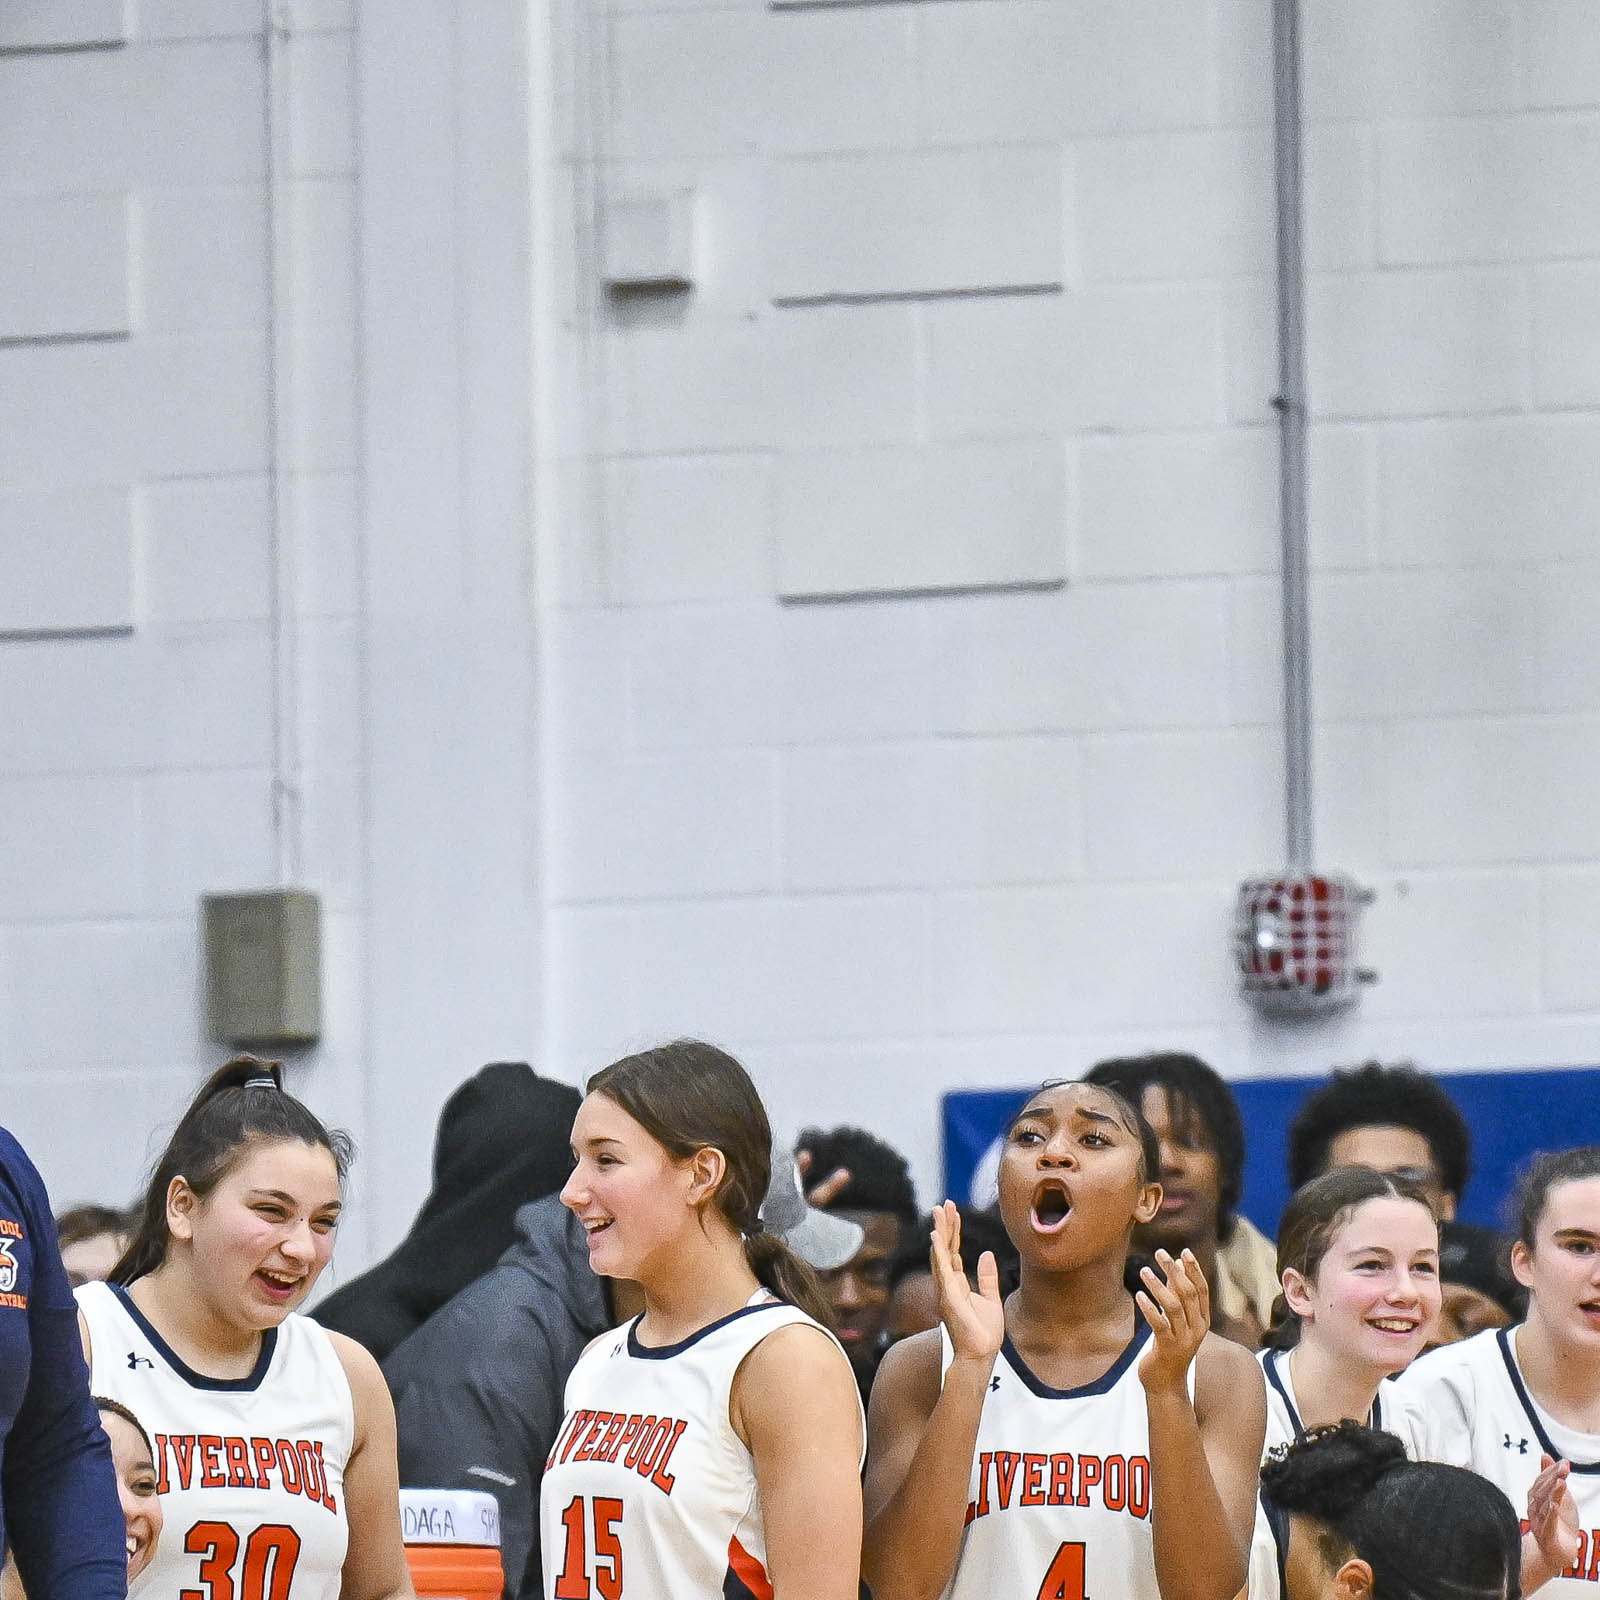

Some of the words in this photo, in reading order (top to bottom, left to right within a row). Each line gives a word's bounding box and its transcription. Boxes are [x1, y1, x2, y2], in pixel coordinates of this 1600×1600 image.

[154, 1433, 337, 1516] IVERPOOL
[963, 1451, 1152, 1529] IVERPOO
[404, 1506, 456, 1538] DAGA
